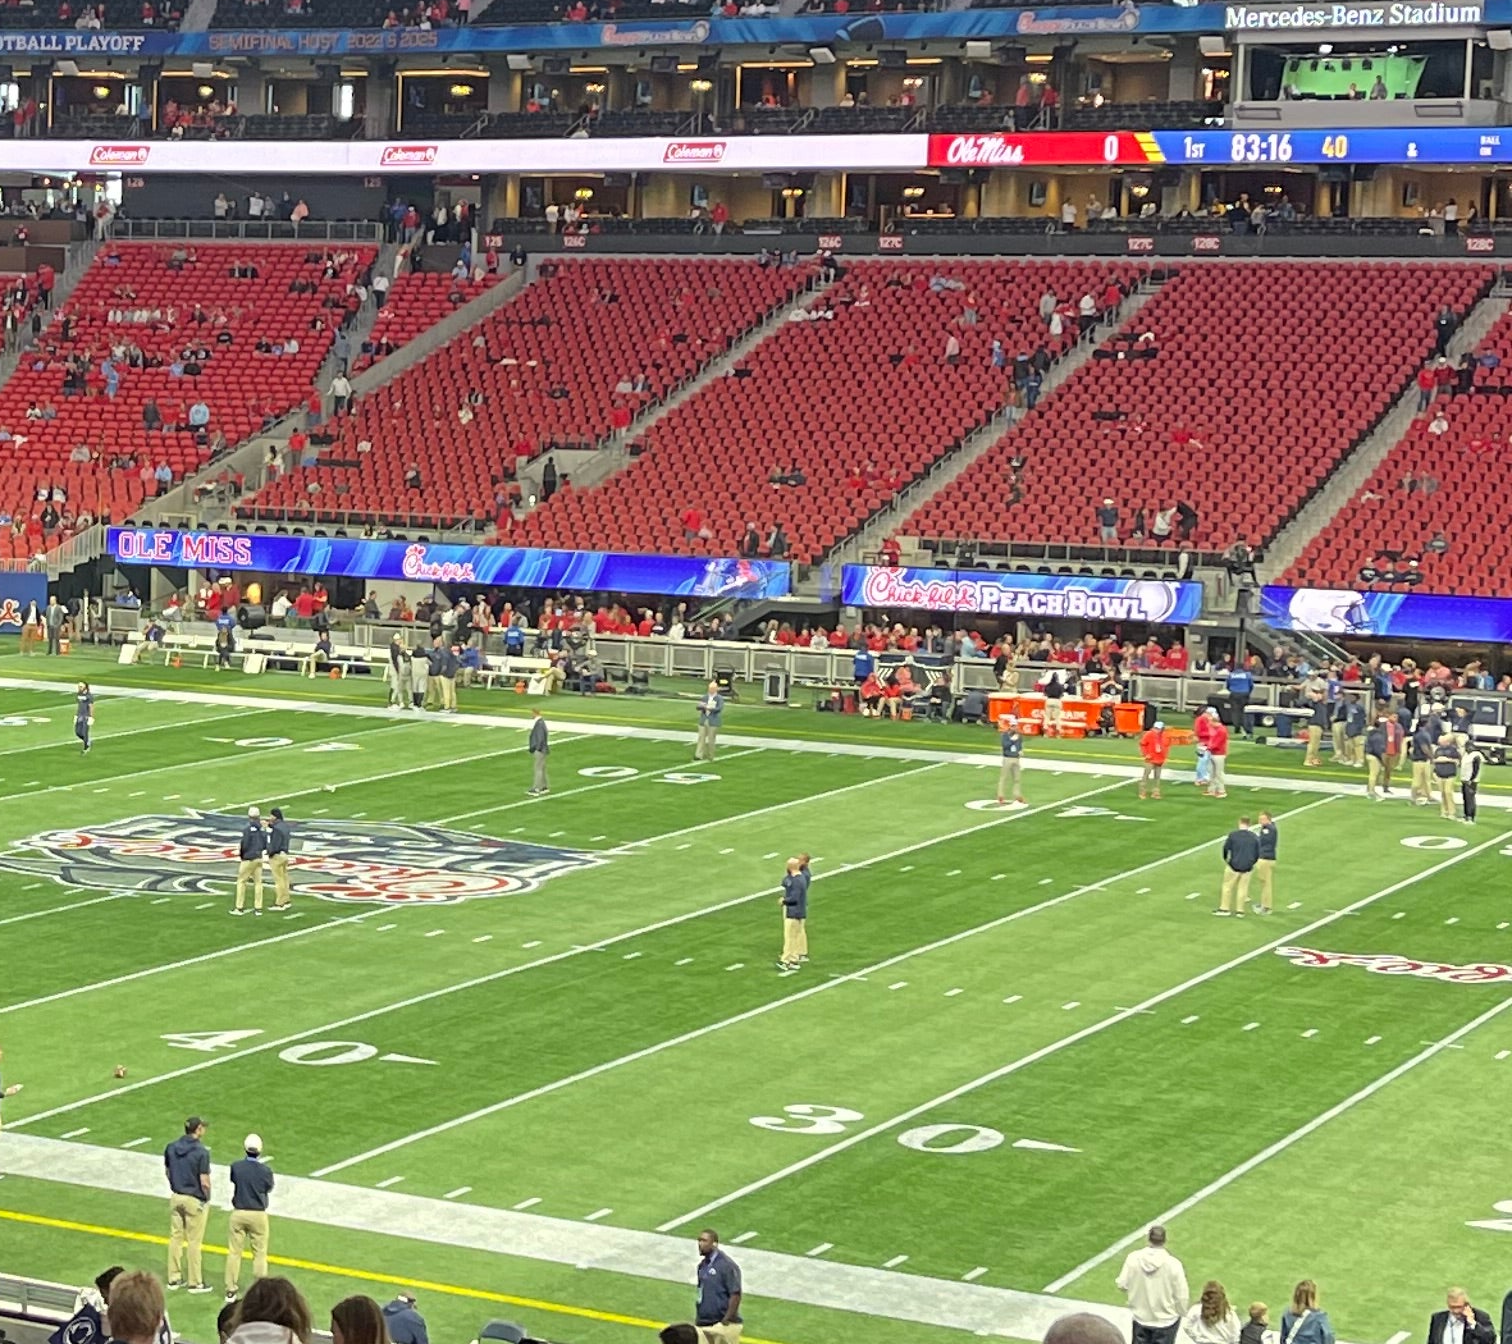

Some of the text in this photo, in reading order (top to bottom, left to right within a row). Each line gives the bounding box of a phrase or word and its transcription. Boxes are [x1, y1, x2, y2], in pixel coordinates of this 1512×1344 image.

[1225, 3, 1481, 29] Mercedes-Benz Stadium
[64, 35, 145, 51] PLAYOFF
[209, 34, 294, 51] SEMIFINAL
[298, 33, 339, 50] HOST
[92, 147, 138, 161] Coleman
[383, 147, 426, 162] Coleman
[667, 143, 714, 158] Coleman
[1104, 135, 1118, 161] 0
[1231, 134, 1292, 161] 83:16
[1321, 136, 1348, 158] 40
[119, 531, 252, 565] OLE MISS
[981, 586, 1065, 614] PEACH
[1067, 590, 1146, 620] BOWL
[160, 1028, 379, 1066] 40
[748, 1103, 1005, 1154] 30
